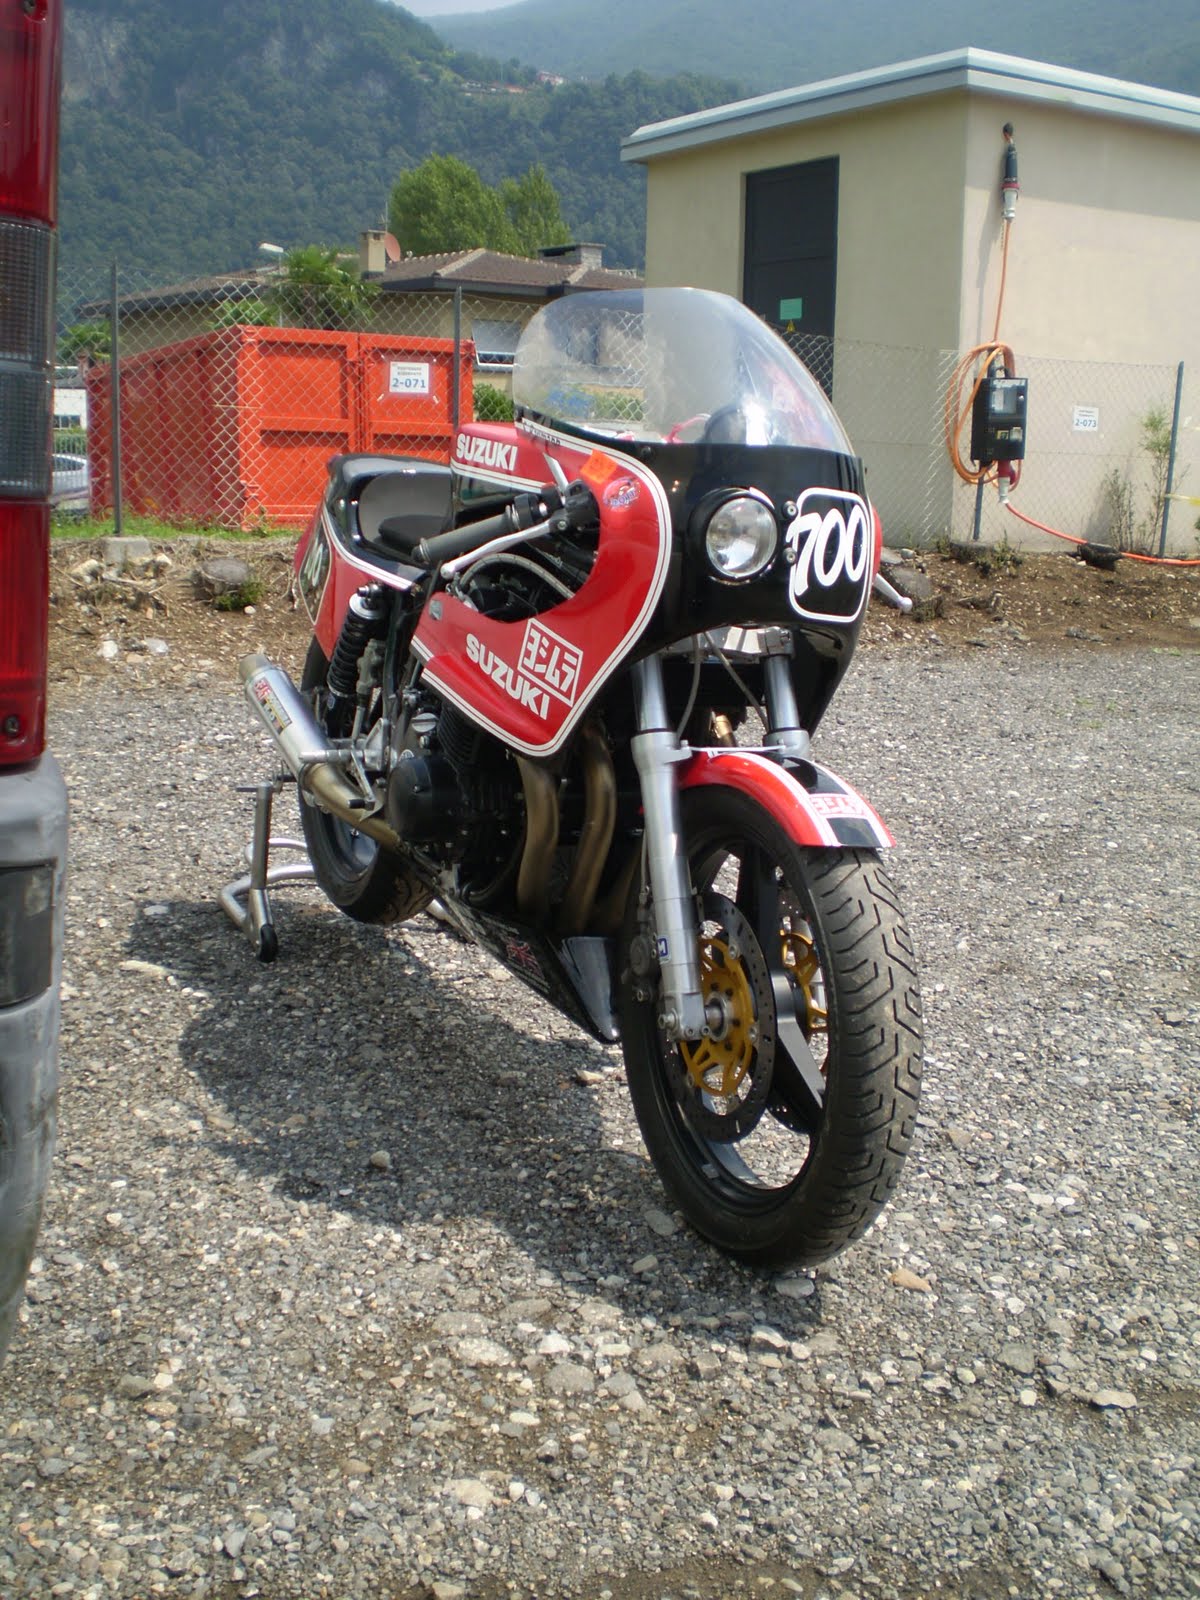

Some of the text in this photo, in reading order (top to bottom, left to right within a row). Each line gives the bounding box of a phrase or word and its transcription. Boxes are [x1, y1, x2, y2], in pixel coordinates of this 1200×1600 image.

[392, 377, 426, 389] 2-071
[1075, 418, 1097, 428] 2-073
[456, 433, 518, 471] SUZUKI
[785, 504, 868, 596] 700
[466, 633, 550, 720] SUZUKI
